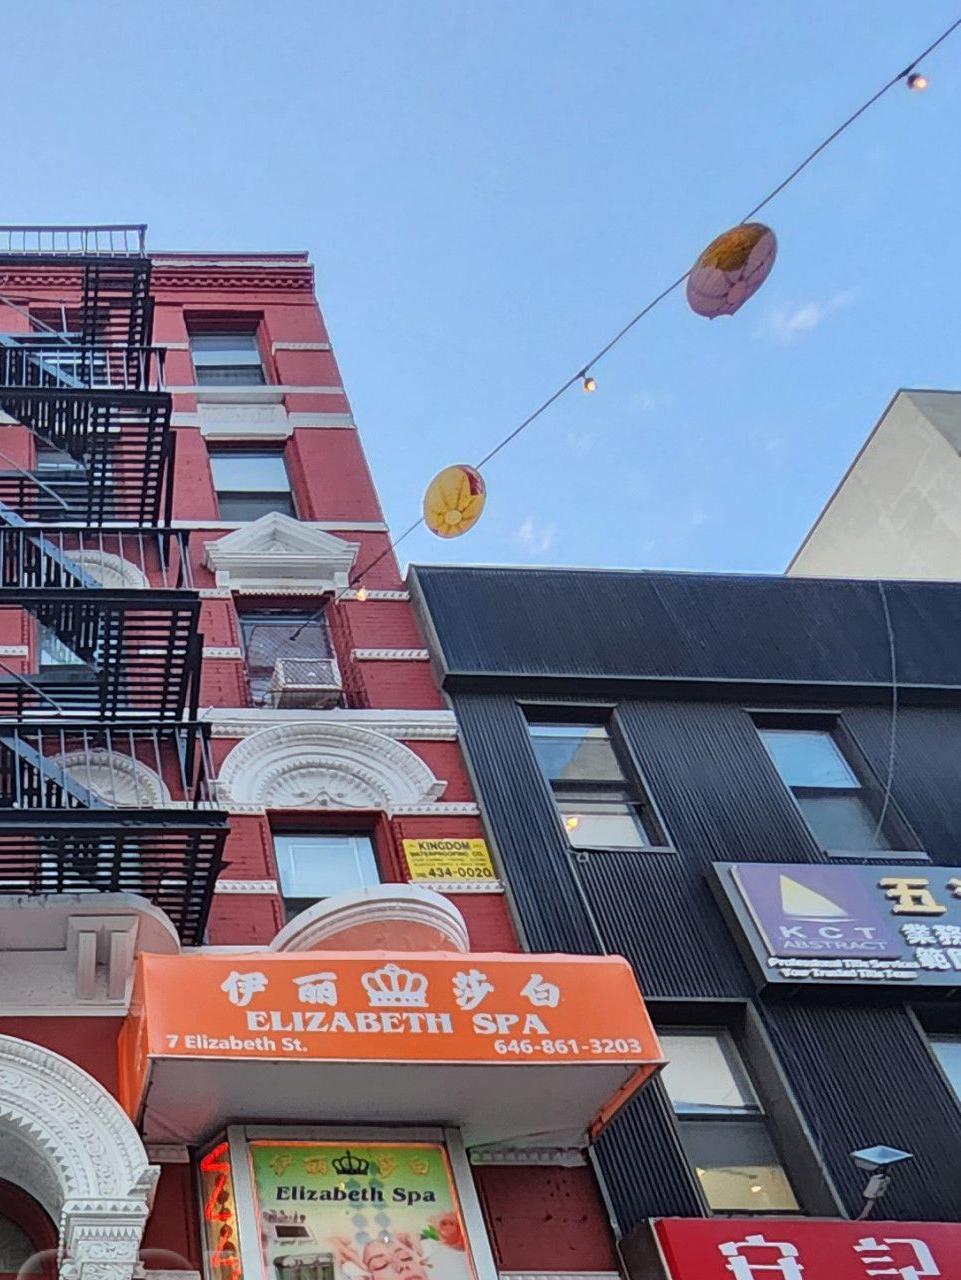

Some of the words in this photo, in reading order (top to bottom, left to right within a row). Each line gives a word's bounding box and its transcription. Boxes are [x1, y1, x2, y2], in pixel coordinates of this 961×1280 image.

[418, 841, 471, 851] KINGDOM
[428, 867, 493, 878] 434-0020
[878, 876, 961, 913] 五
[783, 940, 888, 951] ABSTRACT
[245, 1010, 454, 1034] ELIZABETH
[472, 1012, 550, 1035] SPA
[166, 1034, 179, 1049] 7
[185, 1034, 276, 1051] Elizabeth
[281, 1036, 308, 1053] St.
[494, 1038, 642, 1055] 646-861-3203
[276, 1186, 384, 1202] Elizabeth
[392, 1187, 436, 1206] Spa
